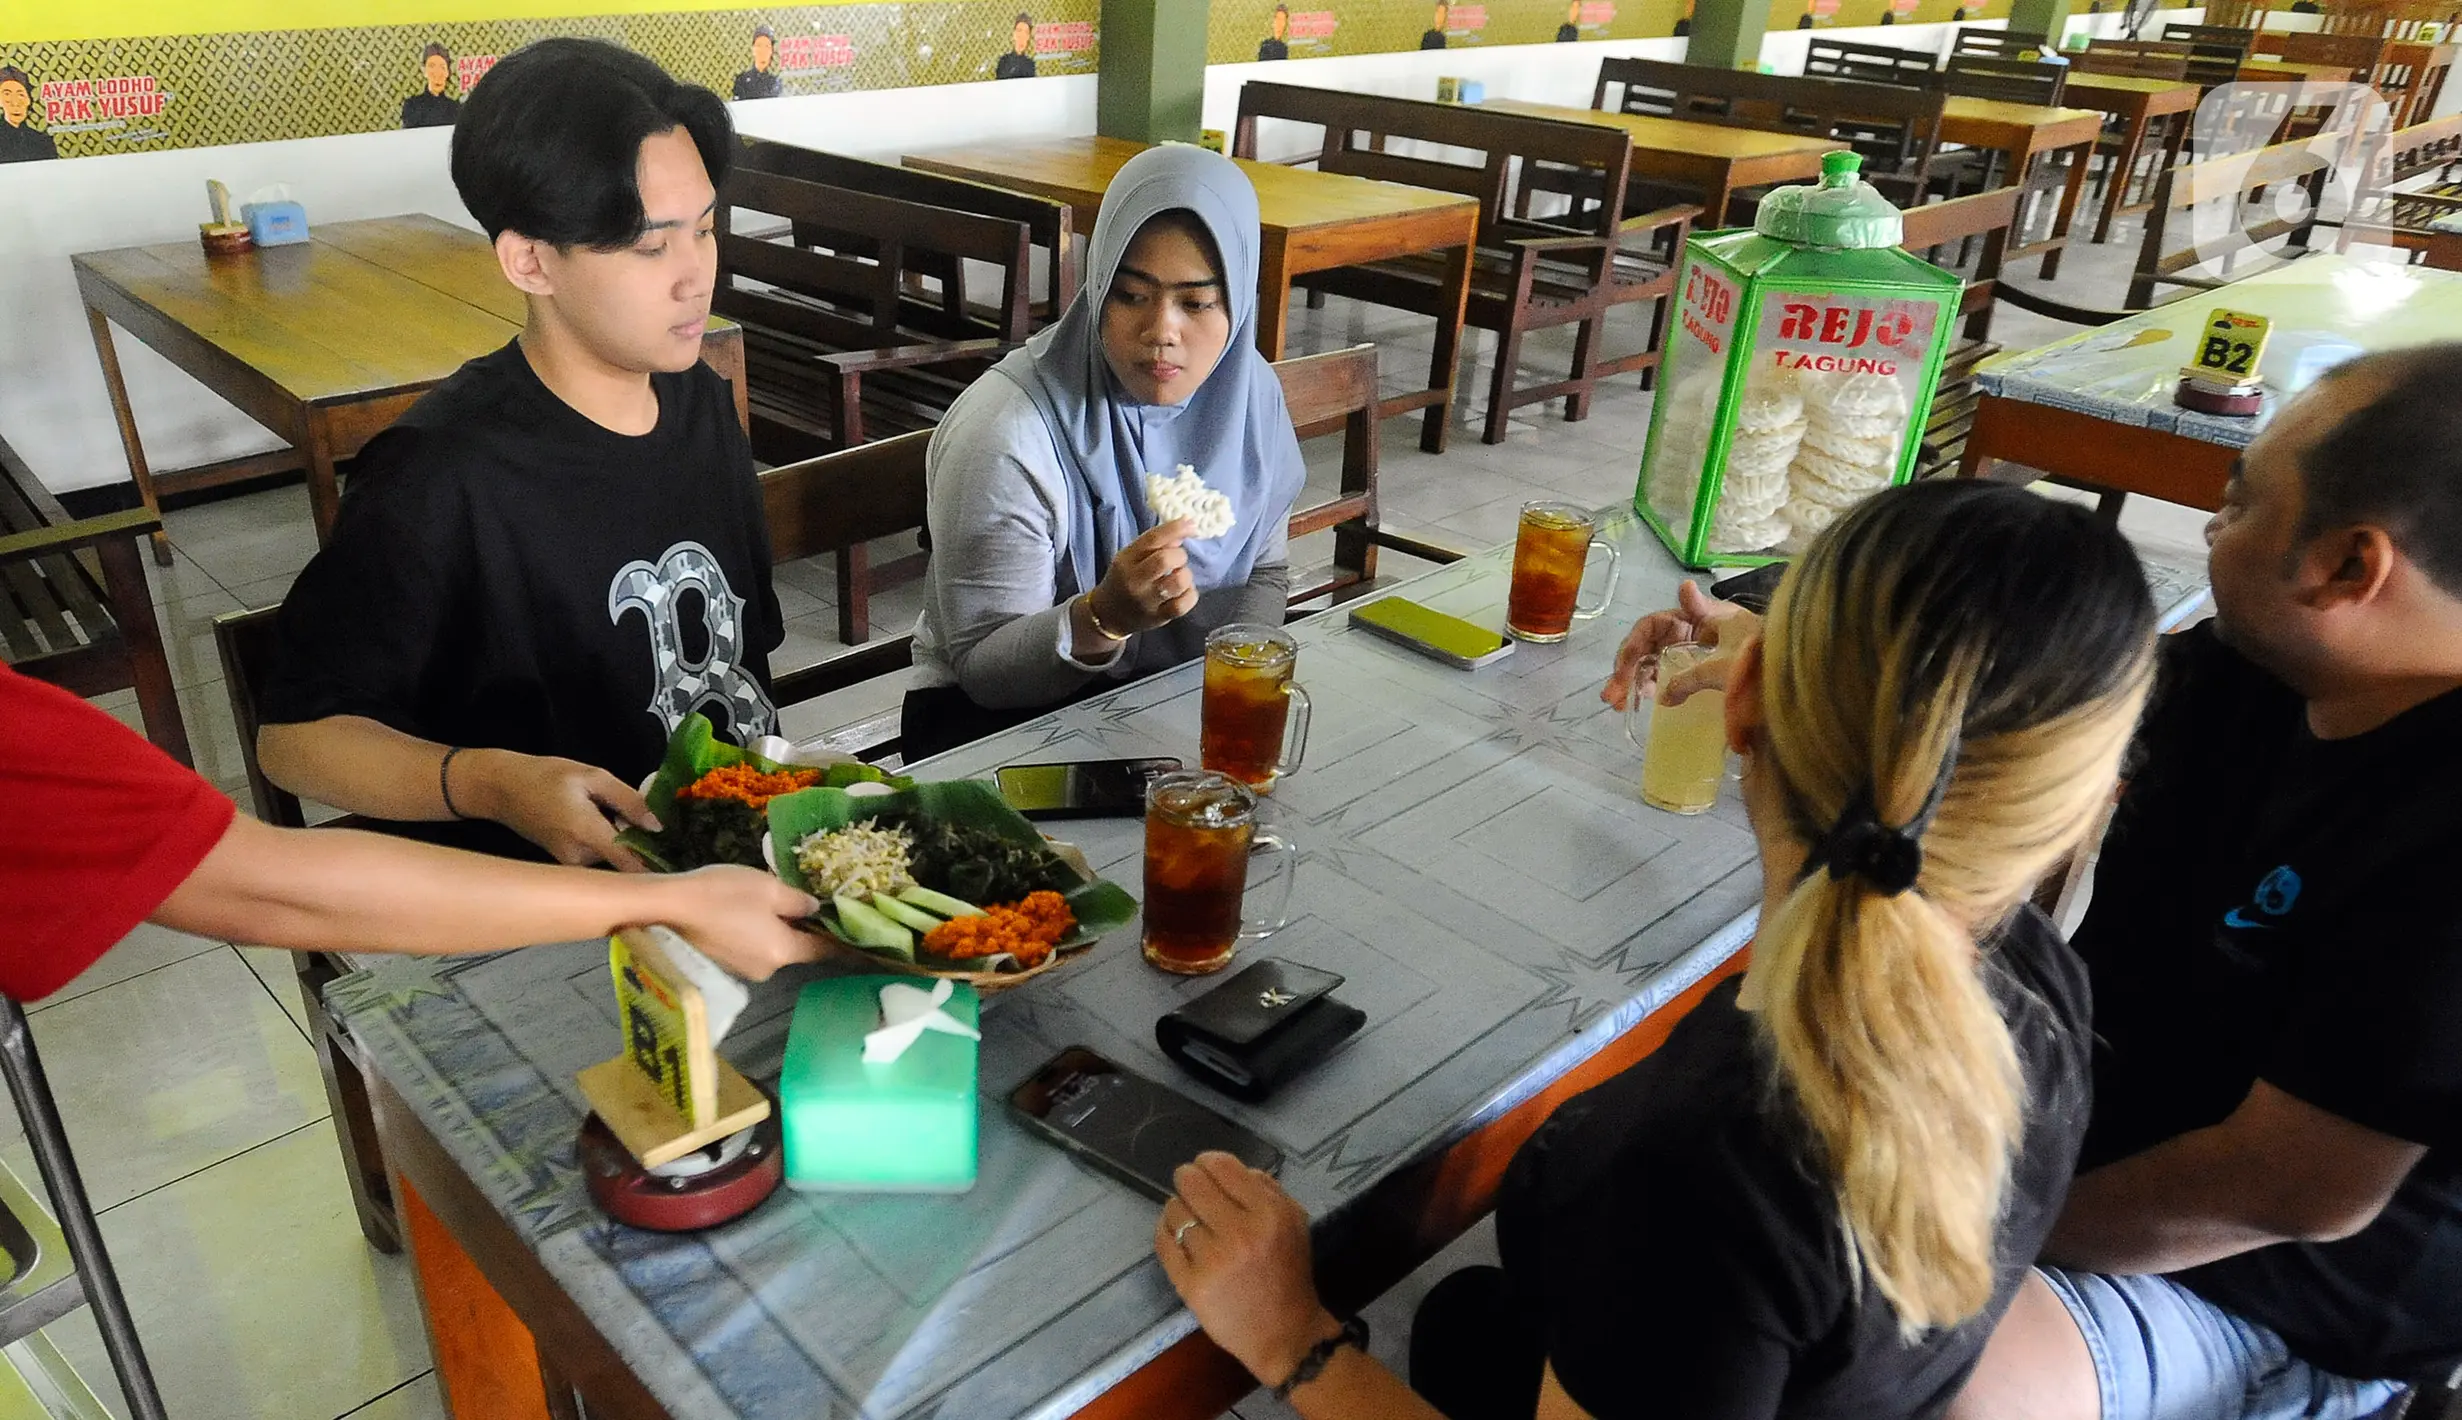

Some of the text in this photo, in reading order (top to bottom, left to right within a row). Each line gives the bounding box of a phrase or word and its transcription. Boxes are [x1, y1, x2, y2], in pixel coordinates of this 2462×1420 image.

[41, 76, 156, 99] AYAM LODHO
[46, 93, 165, 122] PAK YUSUF
[1778, 303, 1914, 349] REJO
[1775, 350, 1898, 376] T.AGUNG
[2200, 336, 2254, 374] B2
[628, 1001, 685, 1112] B1
